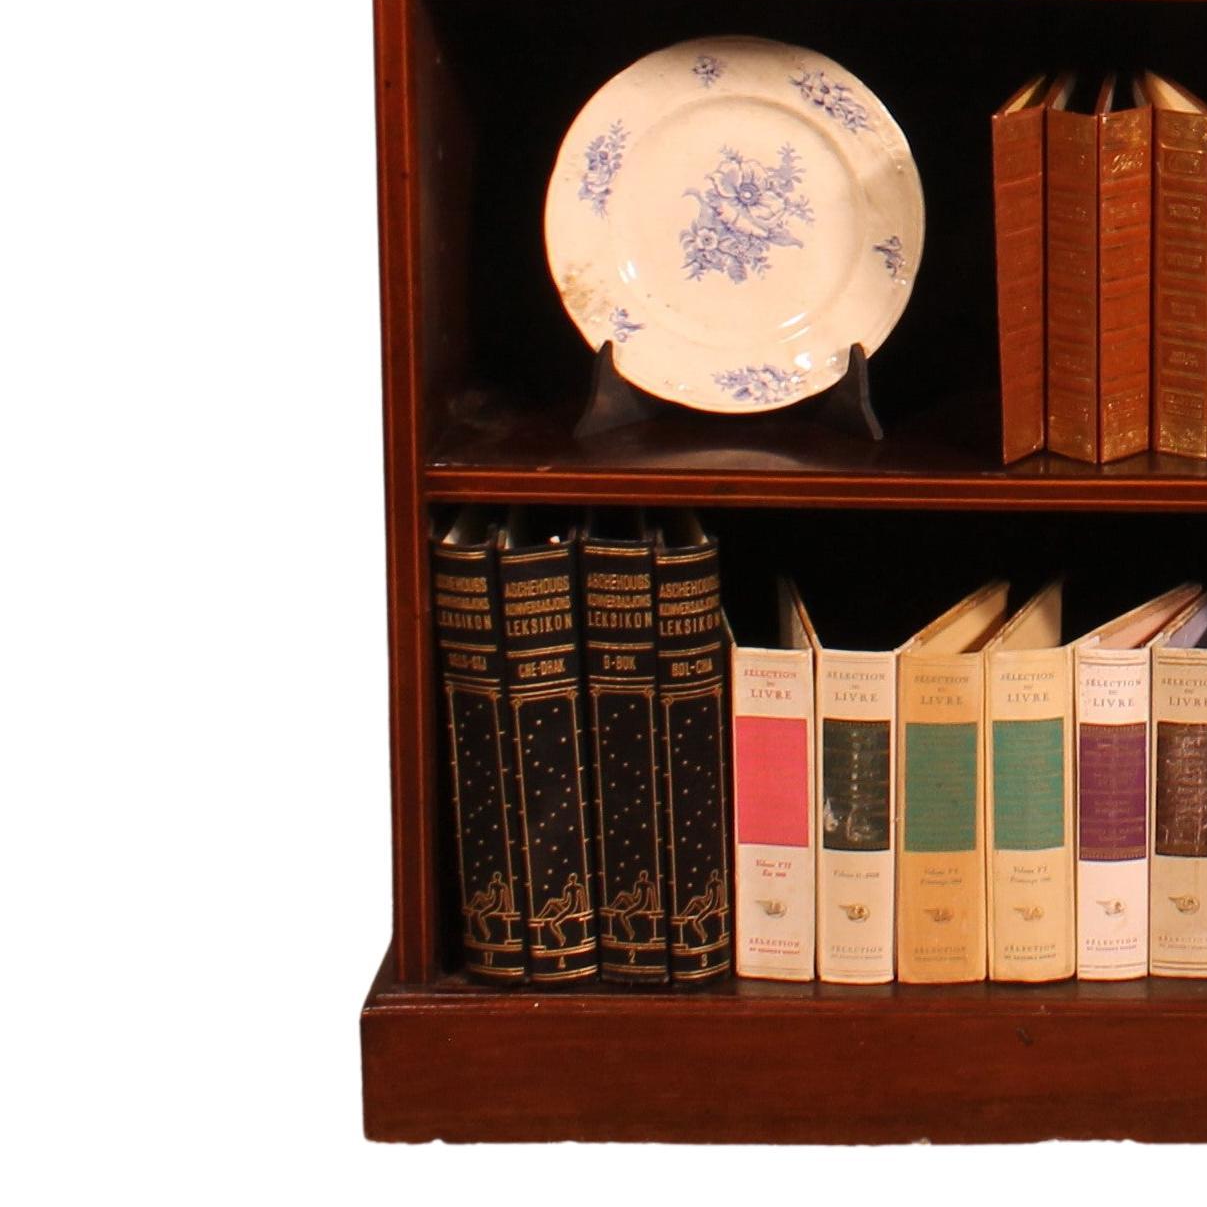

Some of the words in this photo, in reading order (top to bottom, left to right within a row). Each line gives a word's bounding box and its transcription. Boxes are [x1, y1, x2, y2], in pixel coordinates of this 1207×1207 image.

[505, 613, 573, 636] LEKSIKON
[588, 611, 653, 629] LEKSIKON
[660, 613, 721, 636] LEKSIKON
[1085, 678, 1142, 688] SÉLECTION
[751, 688, 792, 700] LIVRE
[834, 692, 879, 703] LIVRE
[1007, 693, 1050, 704] LIVRE
[920, 695, 964, 706] LIVRE
[1093, 699, 1135, 708] LIVRE
[629, 950, 636, 964] 2
